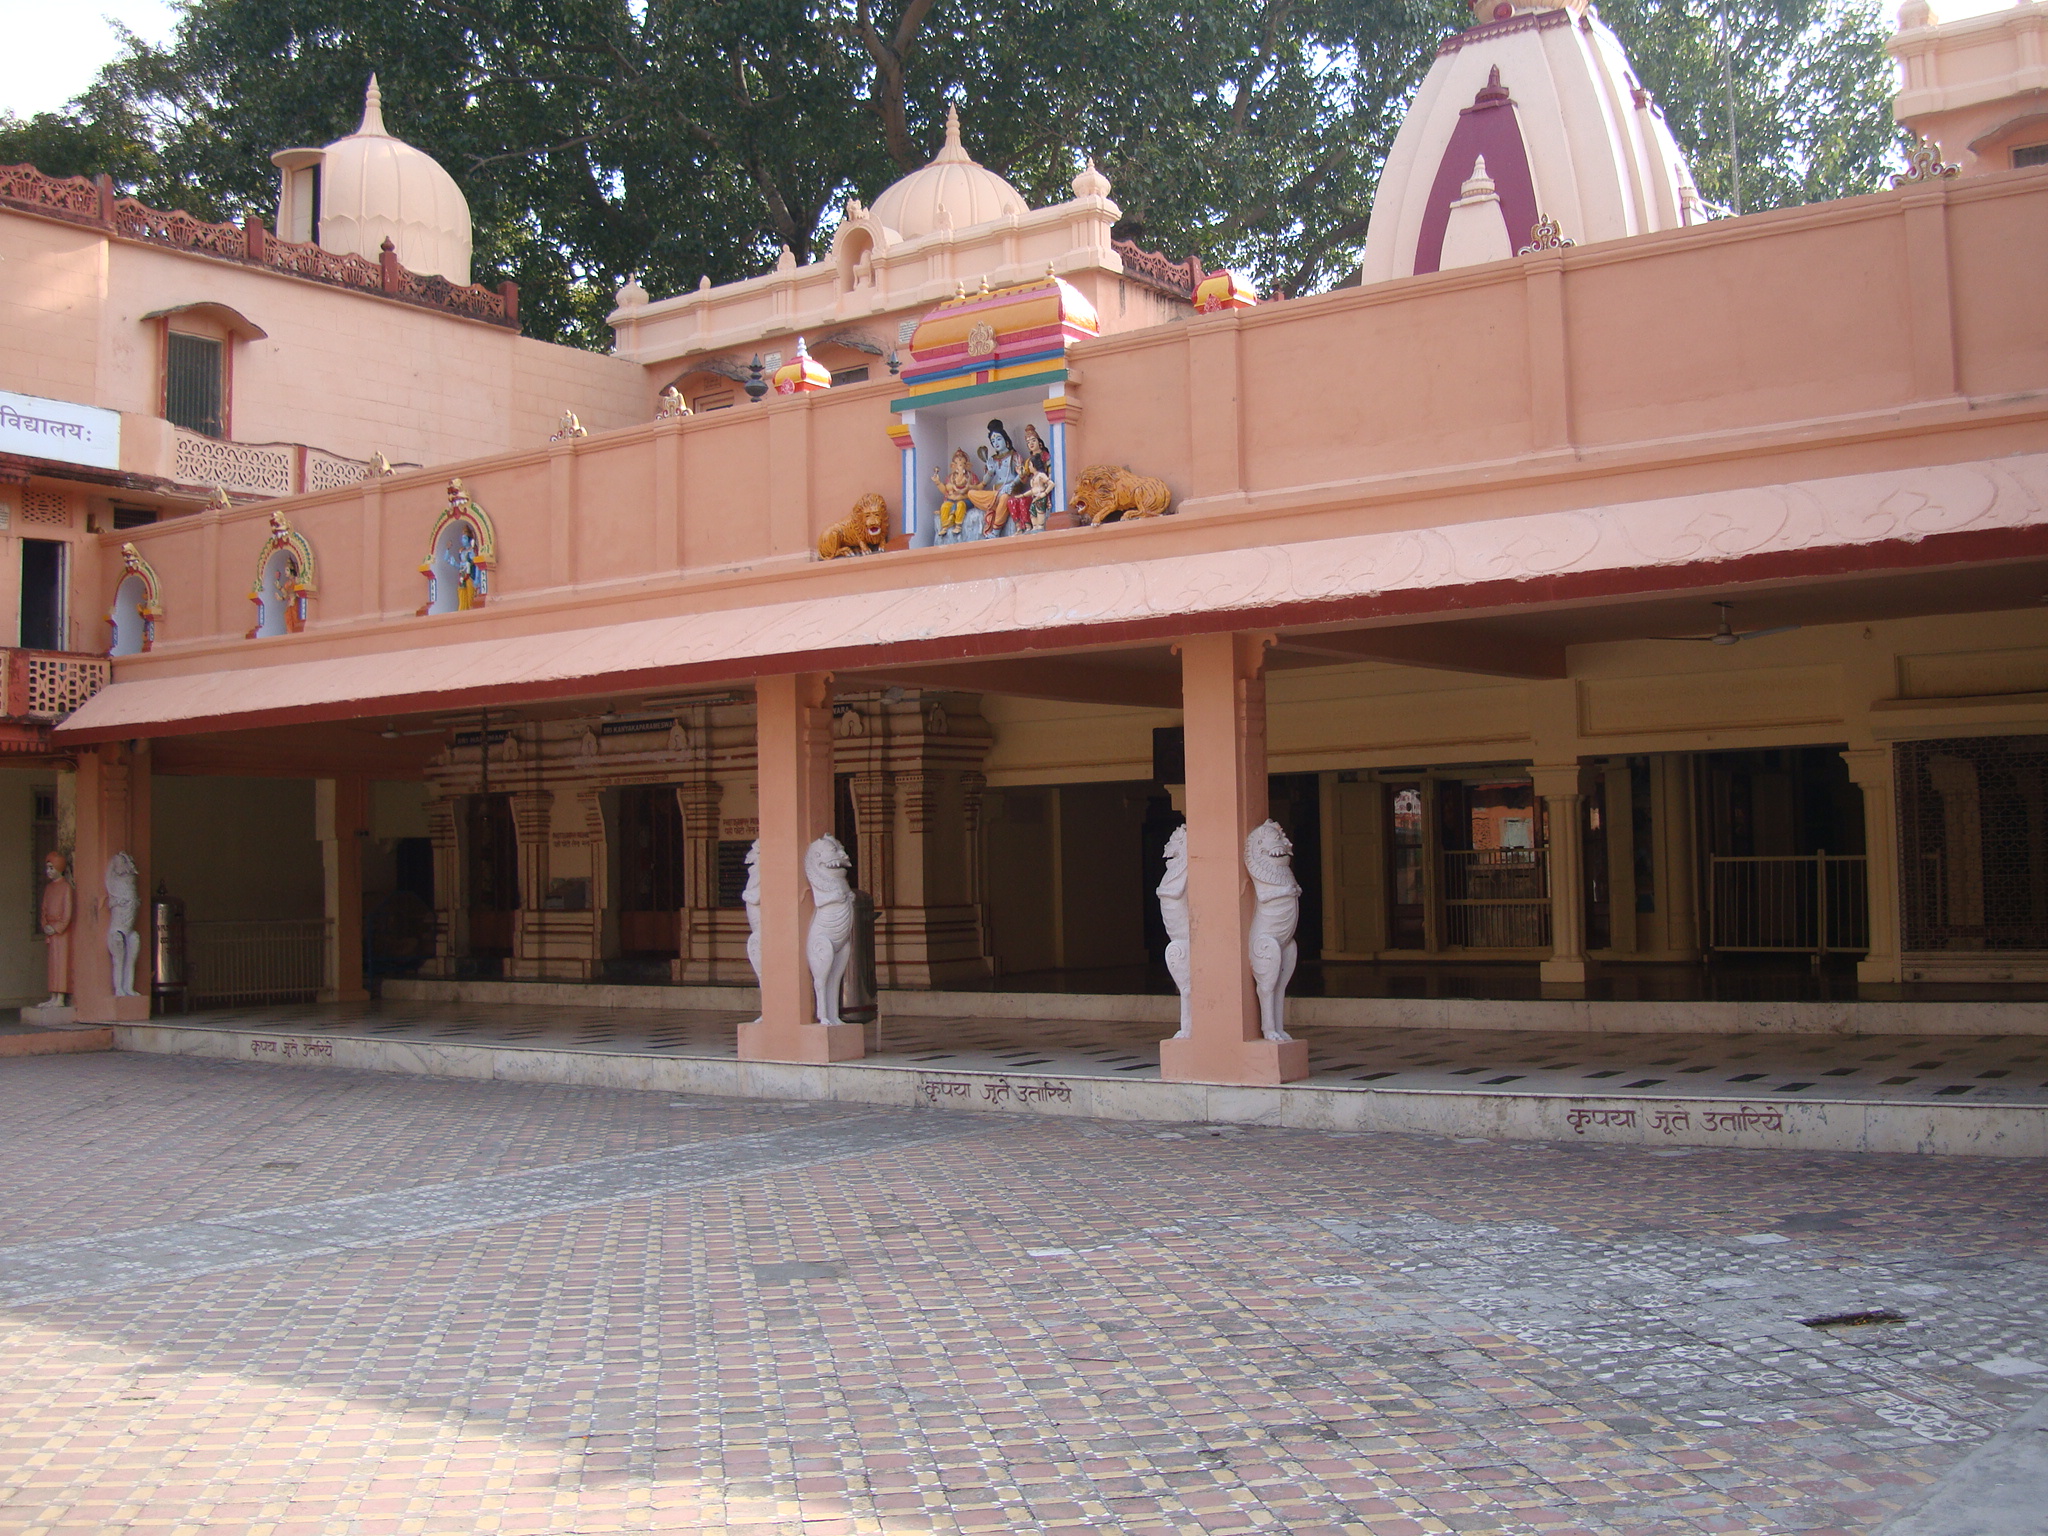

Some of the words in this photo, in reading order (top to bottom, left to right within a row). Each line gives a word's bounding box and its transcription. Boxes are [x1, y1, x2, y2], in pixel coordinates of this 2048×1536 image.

[923, 1080, 972, 1102] कृपया
[979, 1078, 1011, 1105] जूते
[1016, 1081, 1073, 1104] उतारिये
[1566, 1108, 1637, 1135] कृपया
[1646, 1104, 1691, 1137] जूते
[1699, 1105, 1785, 1133] उतारिये
